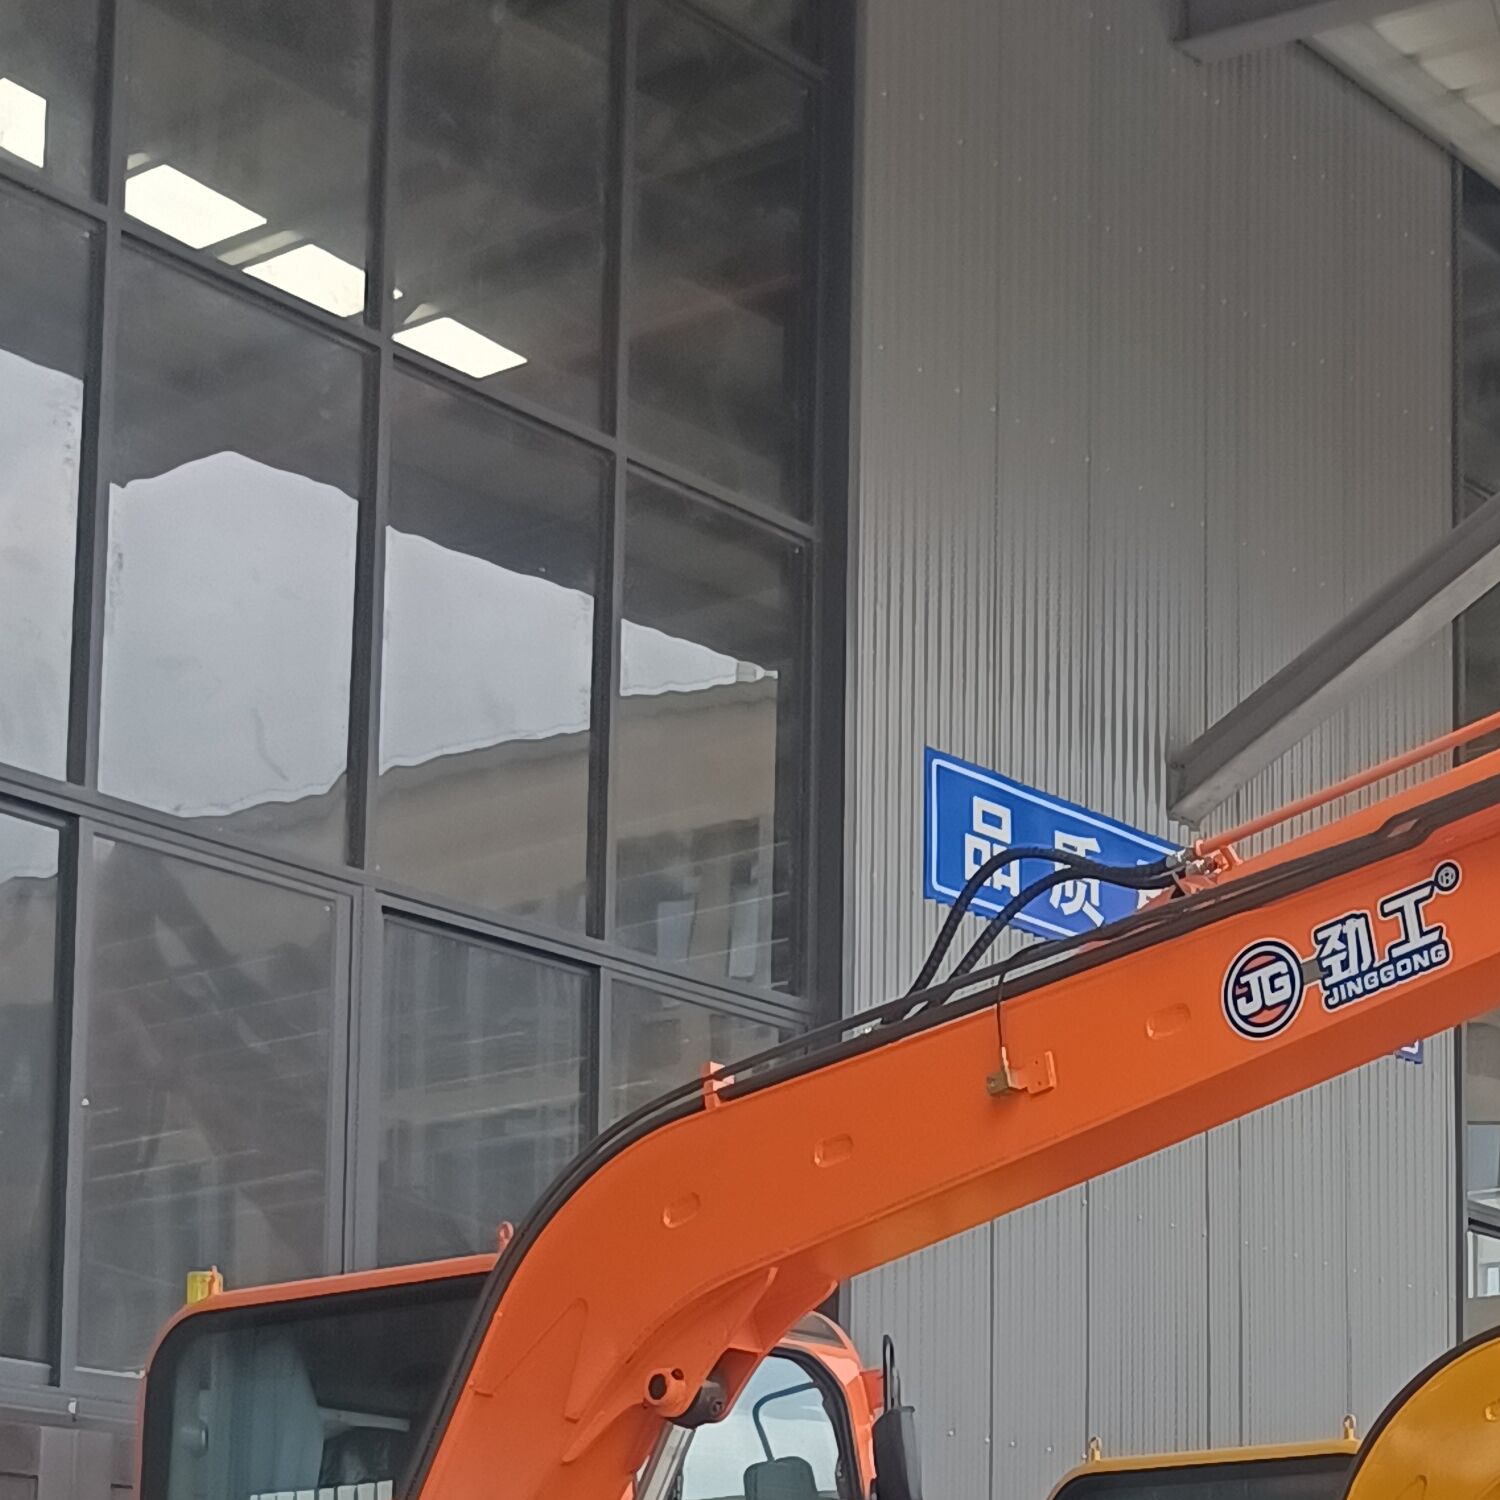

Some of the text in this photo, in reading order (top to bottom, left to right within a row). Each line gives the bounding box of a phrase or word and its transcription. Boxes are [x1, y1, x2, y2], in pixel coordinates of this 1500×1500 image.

[963, 795, 1165, 928] 品质
[1316, 883, 1443, 987] 劲工
[1327, 943, 1447, 1007] JINGGONG
[1235, 960, 1292, 1017] JG
